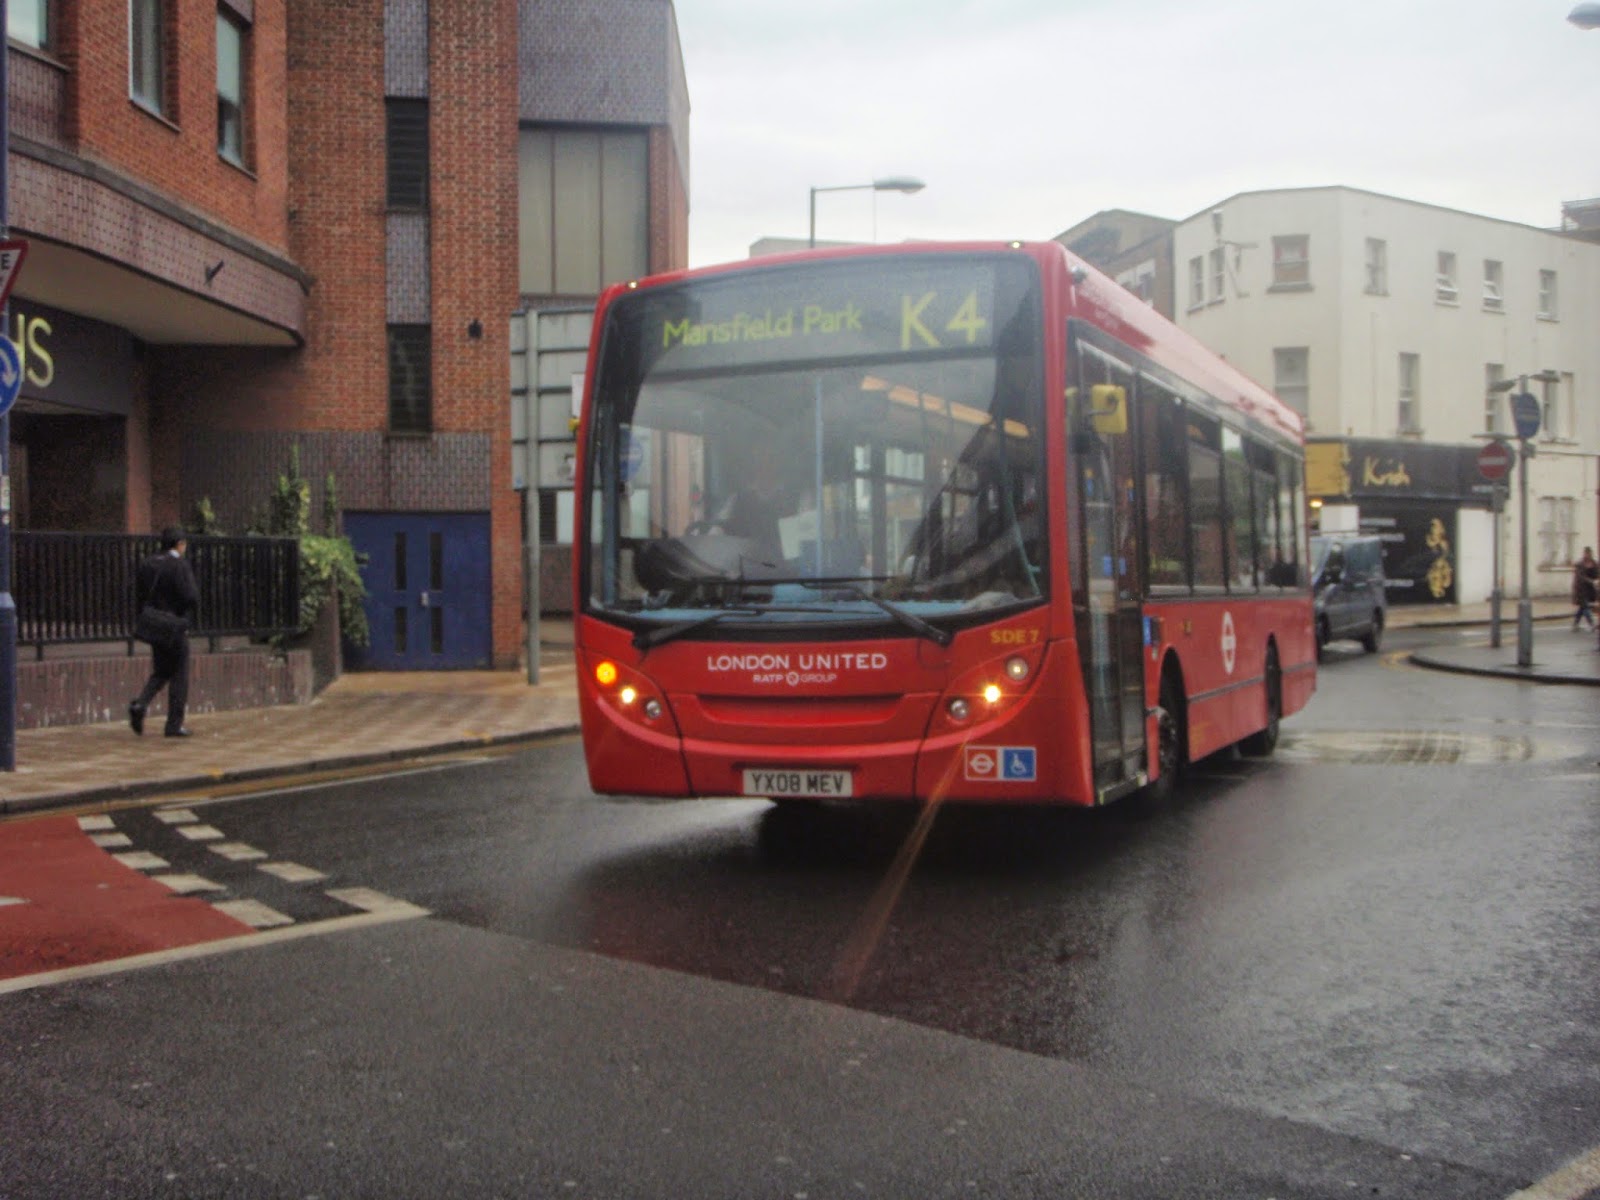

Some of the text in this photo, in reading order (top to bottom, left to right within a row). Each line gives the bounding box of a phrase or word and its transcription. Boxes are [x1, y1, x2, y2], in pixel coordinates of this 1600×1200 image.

[662, 303, 863, 348] Mansfield Park
[902, 289, 987, 350] K 4
[990, 629, 1040, 644] SDE 7
[707, 652, 888, 671] LONDON UNITED
[752, 673, 837, 683] RATP GROUP
[752, 772, 844, 794] YX08 MEV
